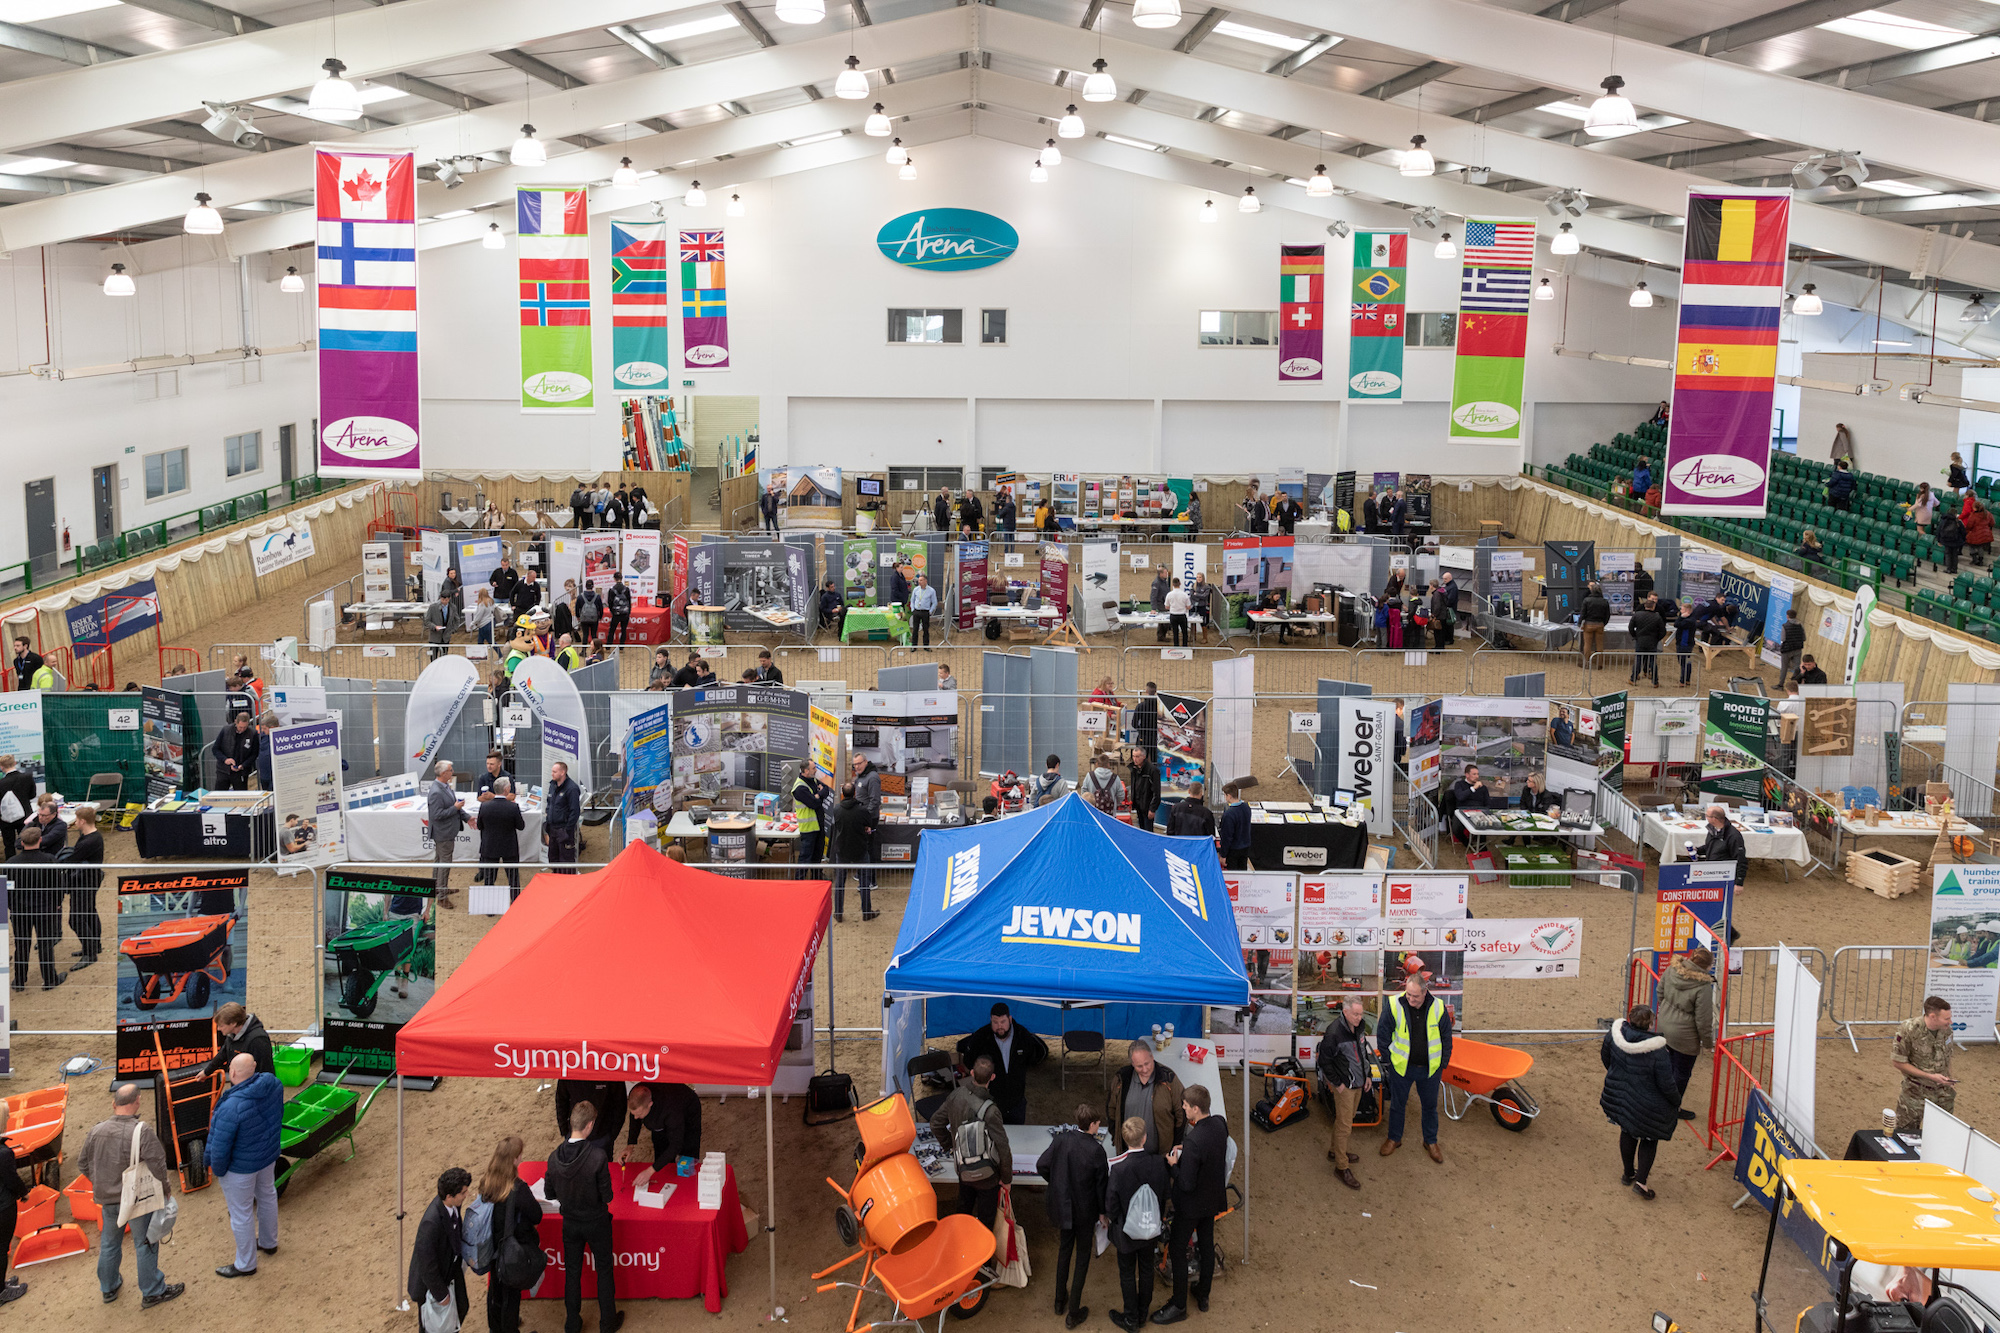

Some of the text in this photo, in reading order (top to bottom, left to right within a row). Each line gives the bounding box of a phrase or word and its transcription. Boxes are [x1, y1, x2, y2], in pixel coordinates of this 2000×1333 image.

[896, 216, 978, 260] Arena
[691, 347, 717, 360] Arena
[622, 363, 652, 380] Arena
[1286, 359, 1310, 373] Arena
[533, 375, 572, 395] Arena
[1357, 374, 1386, 389] Arena
[1462, 404, 1499, 424] Arena
[336, 421, 390, 448] Arena
[1682, 458, 1736, 486] Arena
[256, 550, 282, 566] Rainbow
[1720, 572, 1762, 604] URTON
[1771, 587, 1791, 600] CAREERS
[1734, 598, 1757, 620] ollege
[71, 615, 94, 630] BISHOP
[72, 620, 98, 637] BURTON
[519, 680, 537, 705] Dulux
[704, 690, 736, 700] CTD
[0, 702, 37, 712] Green
[1601, 702, 1625, 713] ROOTED
[1724, 703, 1765, 716] ROOTED
[117, 716, 130, 724] 42
[419, 675, 474, 763] Dulux DECORATOR CENTRE
[1609, 711, 1624, 720] HULL
[1738, 715, 1764, 724] HULL
[275, 735, 289, 744] We
[303, 731, 324, 739] more
[545, 726, 552, 734] We
[559, 732, 570, 740] more
[545, 734, 554, 743] look
[276, 737, 331, 752] look after you
[1348, 709, 1374, 799] weber
[204, 837, 227, 846] altro
[1294, 850, 1323, 860] weber
[950, 844, 980, 906] JEWSON
[1968, 878, 2000, 886] trainin
[120, 875, 246, 892] BucketBarrow
[328, 876, 434, 894] BucketBarrow
[1164, 848, 1200, 917] JEWSON
[1662, 890, 1719, 901] CONSTRUCTION
[1973, 888, 2000, 896] group
[1232, 906, 1268, 915] PACTING
[1662, 904, 1669, 913] IS
[1002, 904, 1142, 946] JEWSON
[1661, 915, 1690, 924] CAEER
[1466, 929, 1486, 937] tors
[1530, 922, 1576, 938] CONSIDERATE
[1660, 927, 1689, 937] LIK NO
[1480, 940, 1521, 954] safety
[1530, 940, 1575, 955] CONSTRUCTORS
[1660, 939, 1683, 948] OTER
[789, 927, 819, 1019] Symphony
[342, 1045, 395, 1054] BucketBarr
